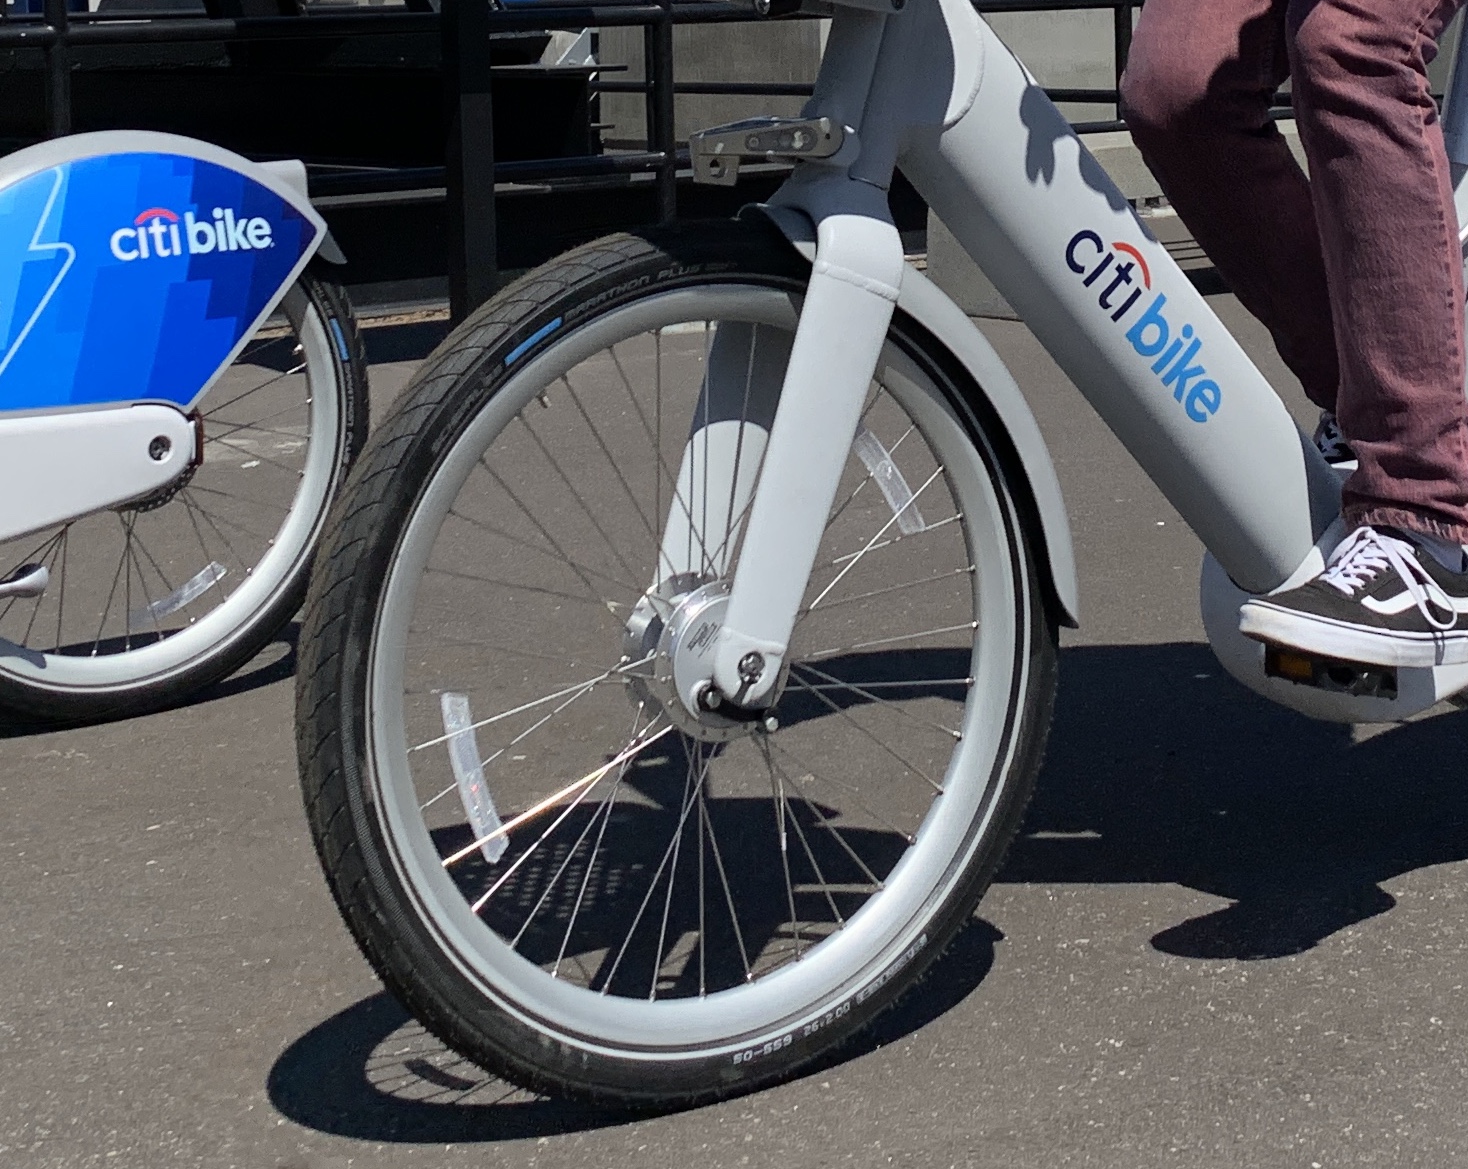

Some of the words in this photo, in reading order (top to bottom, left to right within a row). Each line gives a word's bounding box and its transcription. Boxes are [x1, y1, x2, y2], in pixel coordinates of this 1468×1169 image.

[184, 207, 273, 254] bike
[1065, 230, 1150, 323] citi
[1125, 292, 1222, 423] bike
[733, 1034, 792, 1064] 50-559
